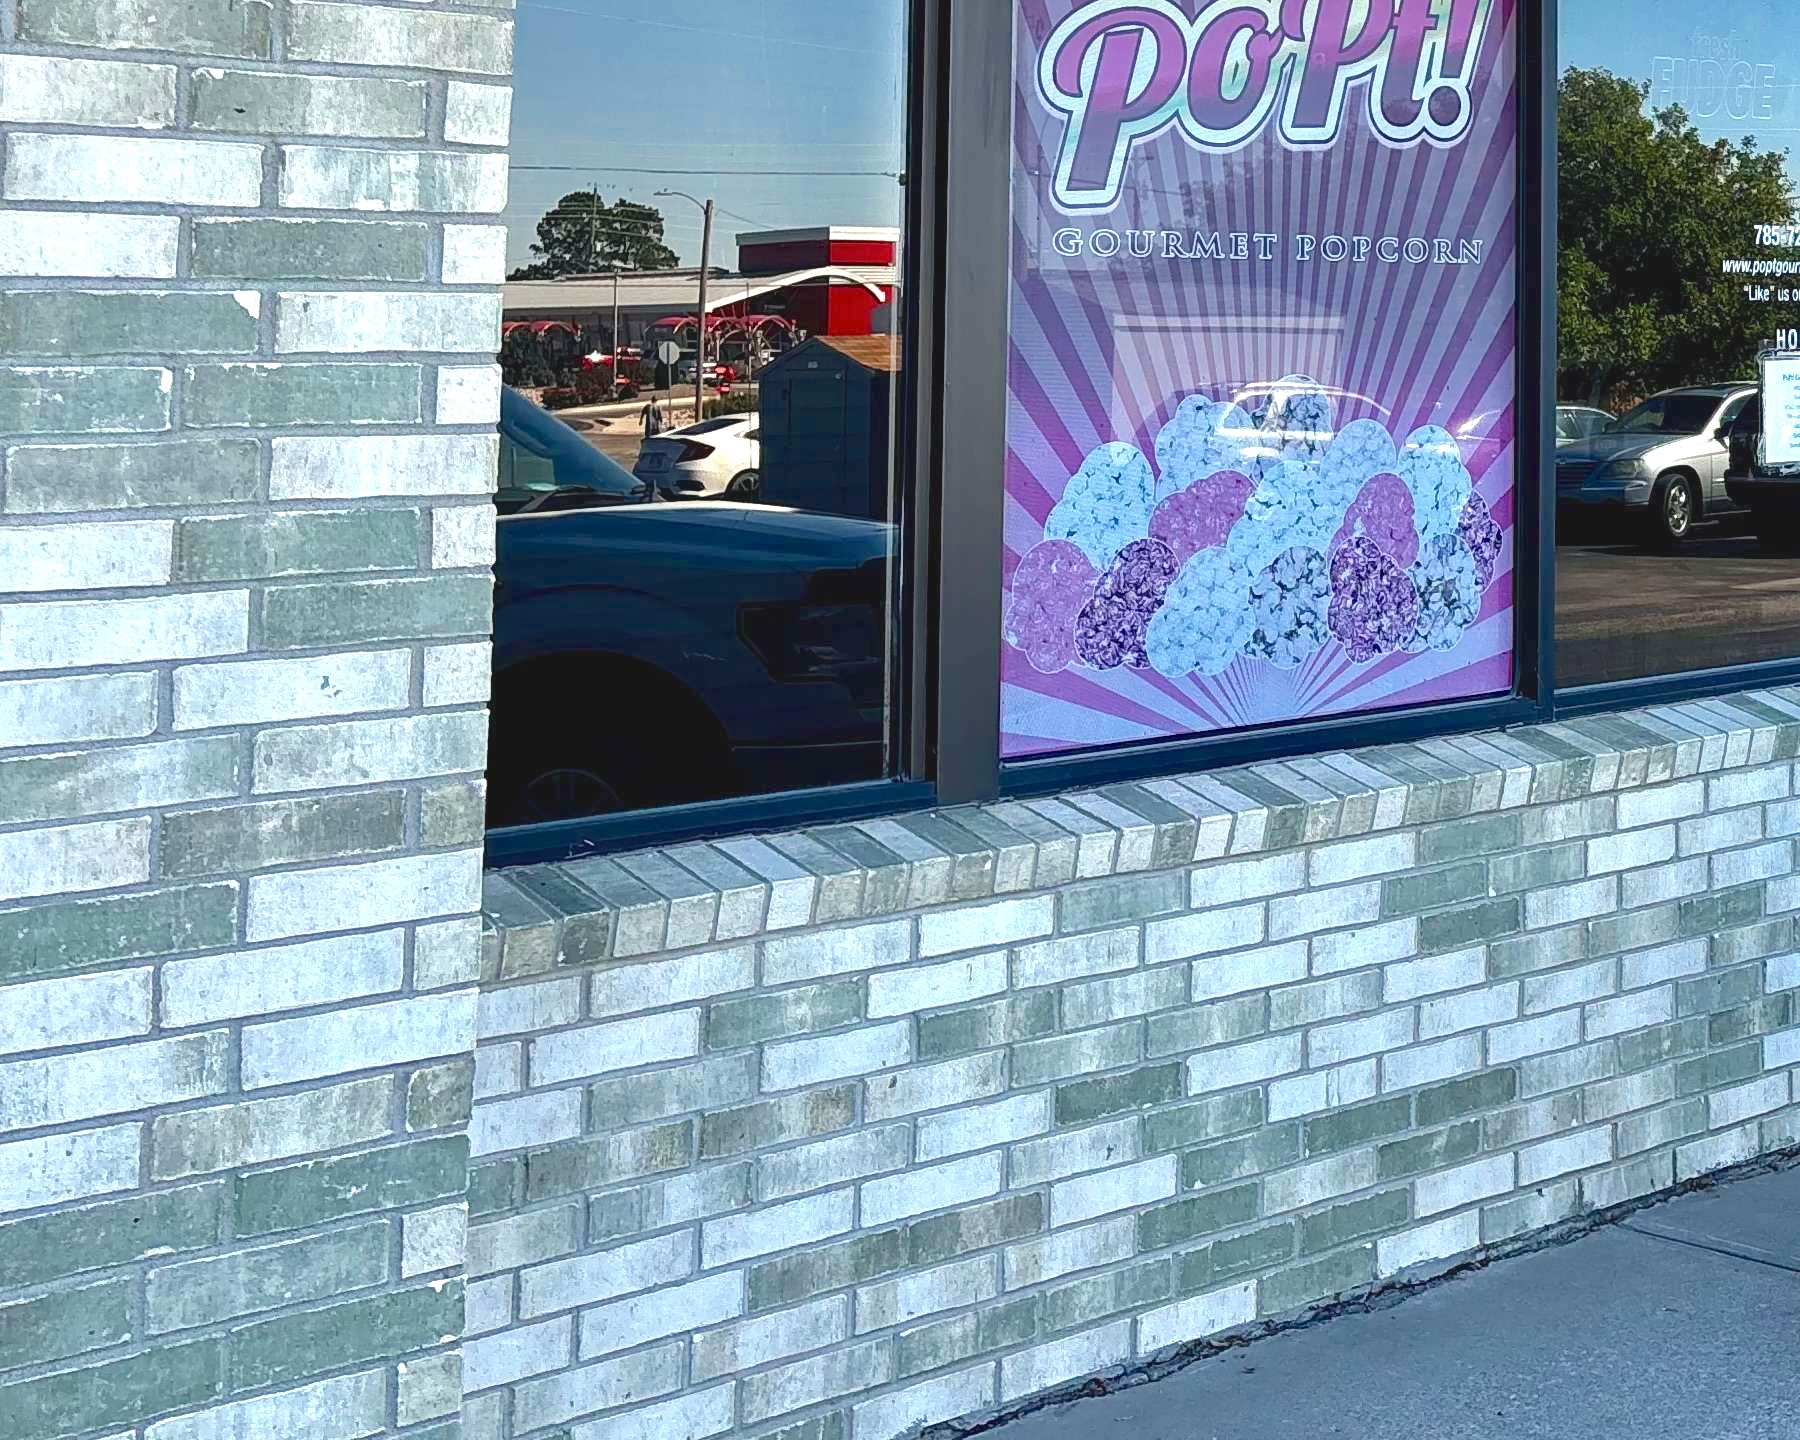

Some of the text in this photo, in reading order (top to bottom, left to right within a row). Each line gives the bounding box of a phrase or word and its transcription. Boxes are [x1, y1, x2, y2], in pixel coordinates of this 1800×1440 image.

[1052, 228, 1484, 264] GOURMET POPCORN
[1777, 288, 1790, 301] us
